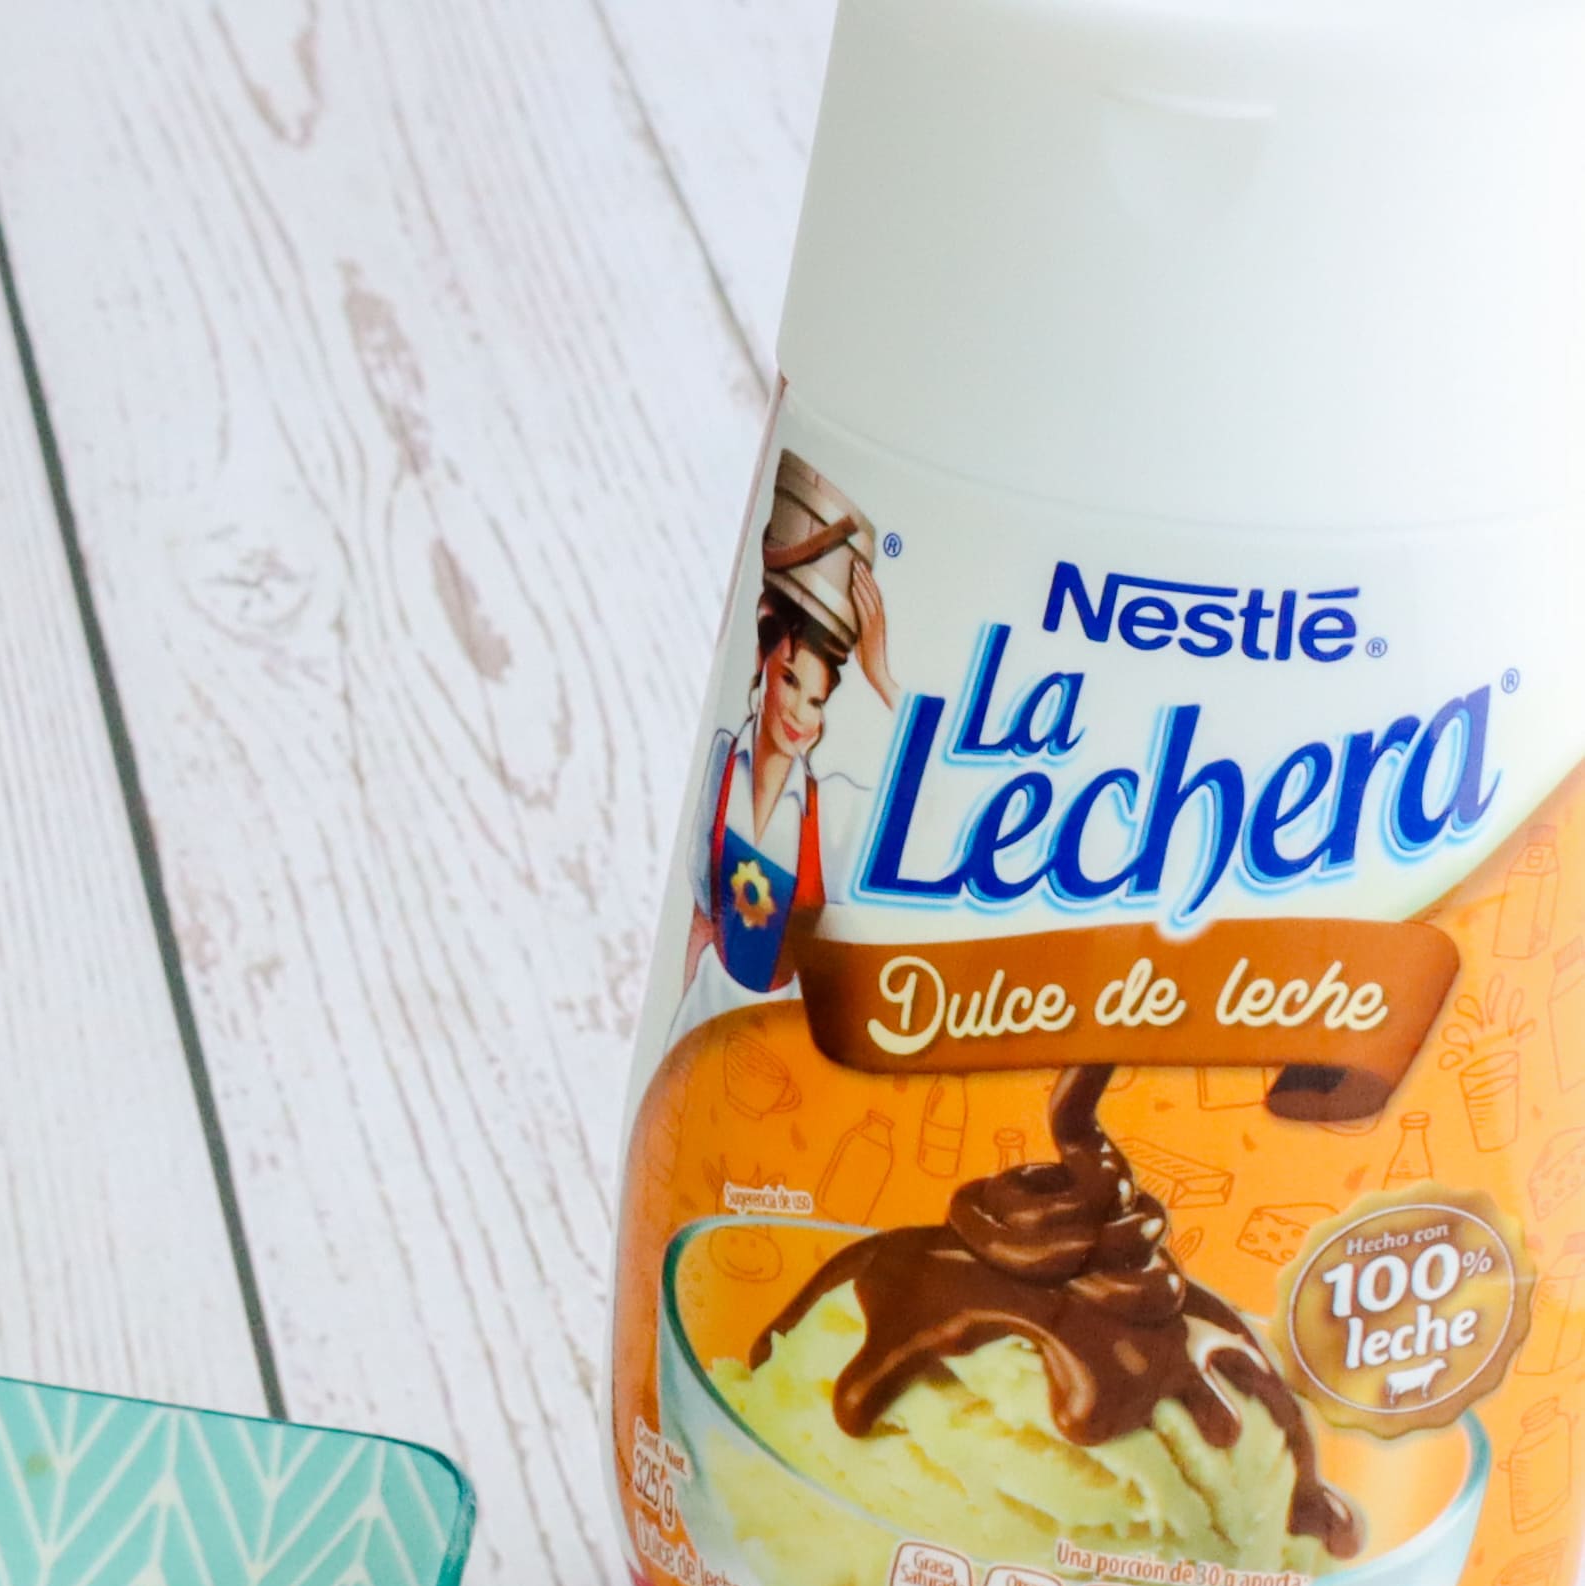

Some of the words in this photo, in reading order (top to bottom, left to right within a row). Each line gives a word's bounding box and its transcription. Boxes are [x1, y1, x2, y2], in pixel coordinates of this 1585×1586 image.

[960, 623, 1086, 756] La
[858, 684, 1501, 917] Lechera
[867, 956, 1074, 1055] Dulce
[1094, 957, 1186, 1028] de
[1216, 958, 1388, 1030] leche
[1346, 1232, 1409, 1256] Hecho
[1413, 1224, 1449, 1243] con
[1345, 1304, 1478, 1369] leche
[913, 1550, 954, 1576] Grasa
[1057, 1541, 1091, 1569] Una
[1096, 1553, 1164, 1581] porción
[1169, 1561, 1192, 1583] de
[1196, 1565, 1220, 1586] 30
